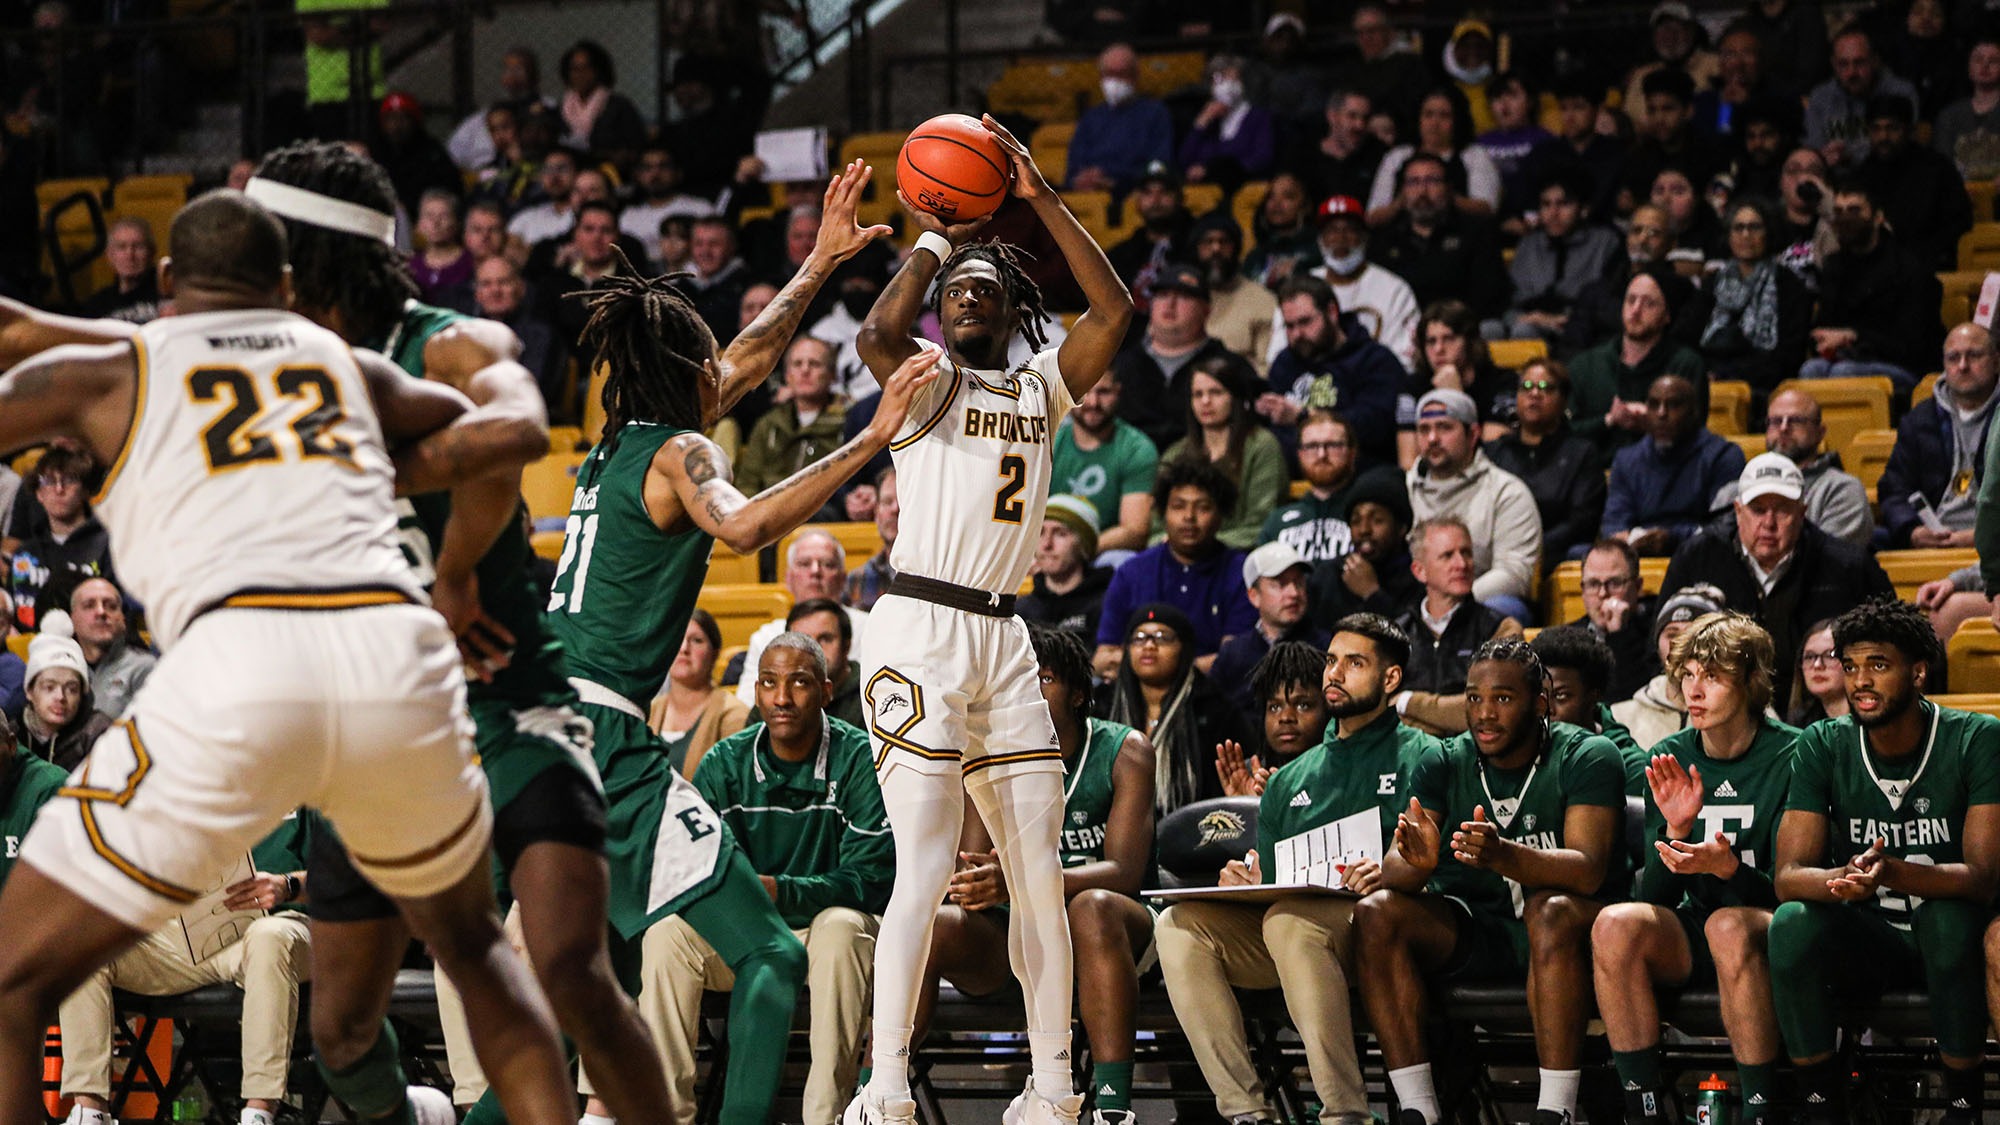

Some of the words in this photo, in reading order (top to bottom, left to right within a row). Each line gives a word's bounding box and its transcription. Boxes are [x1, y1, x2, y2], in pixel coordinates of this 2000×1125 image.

[917, 192, 958, 215] PRO
[184, 364, 365, 476] 22
[992, 453, 1027, 525] 2
[547, 513, 600, 613] 21
[1377, 772, 1397, 795] E
[675, 806, 716, 843] E
[1850, 817, 1951, 848] EASTERN
[5, 835, 19, 858] E
